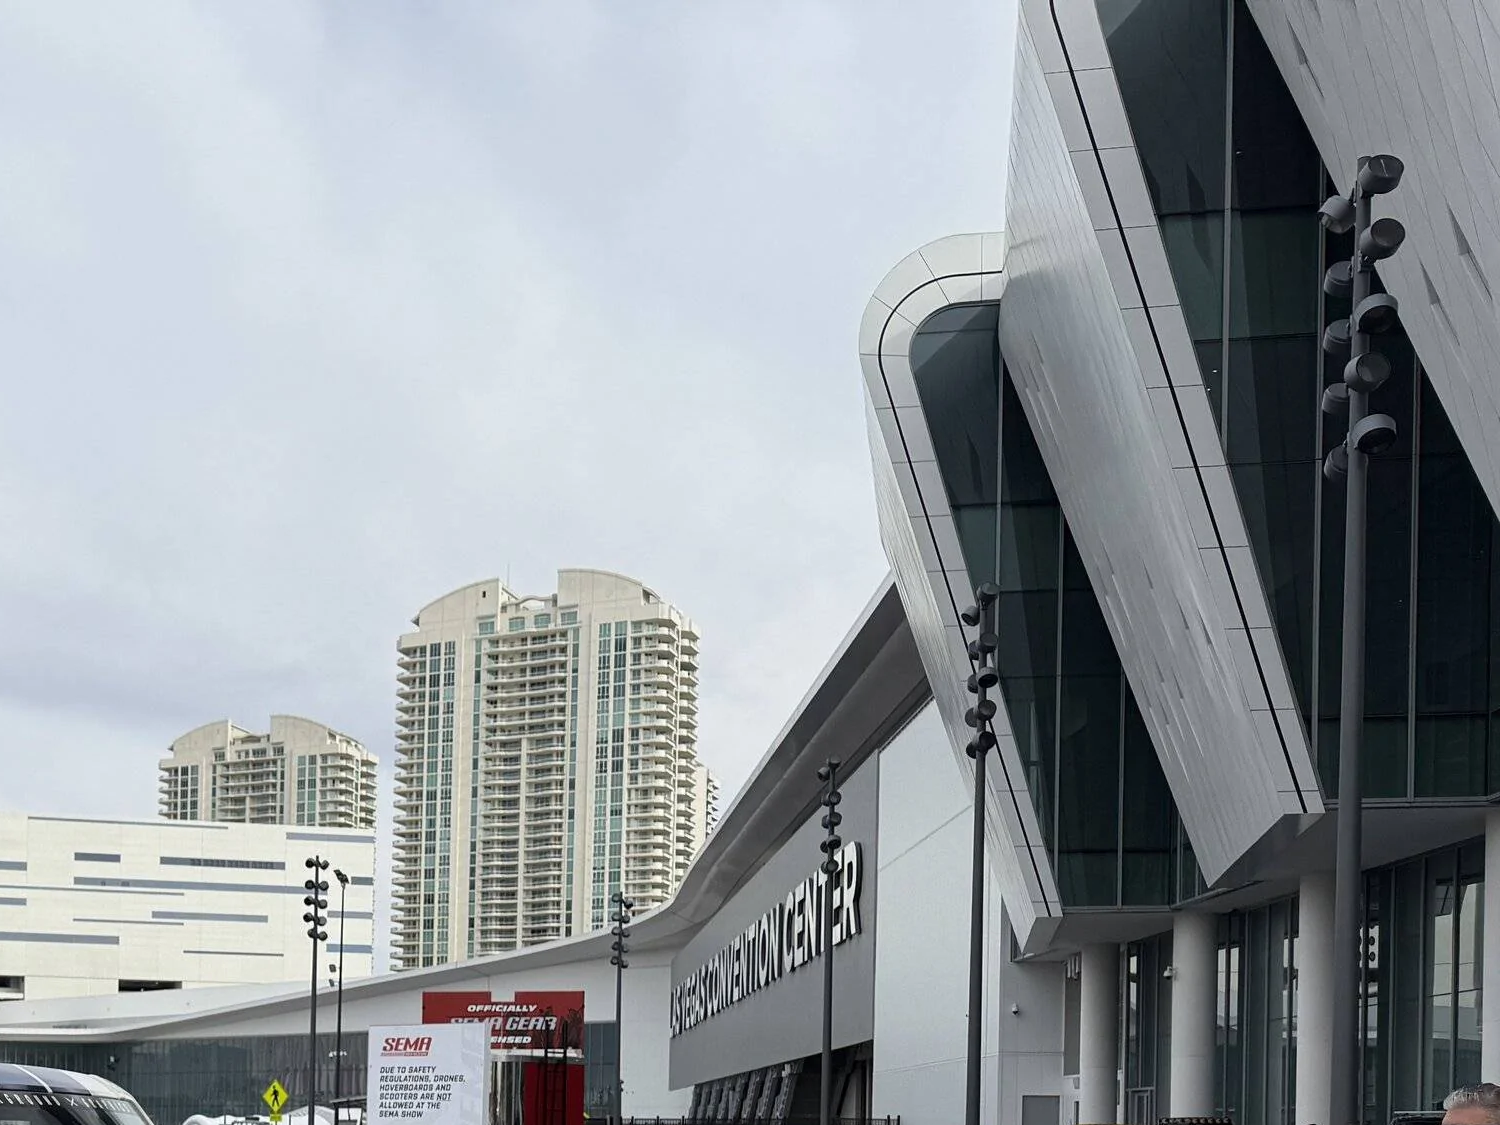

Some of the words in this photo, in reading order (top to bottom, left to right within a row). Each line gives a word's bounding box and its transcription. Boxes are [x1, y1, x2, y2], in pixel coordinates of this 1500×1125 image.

[681, 964, 706, 1032] VEGAS
[705, 903, 782, 1017] CONVENTION
[784, 841, 862, 972] CENTER
[467, 1004, 538, 1013] OFFICIALLY
[505, 1016, 557, 1031] GEAR
[382, 1036, 433, 1052] SEMA
[490, 1035, 532, 1044] ENSED
[380, 1066, 395, 1074] DUE
[397, 1066, 407, 1074] TO
[408, 1066, 437, 1074] SAFETY
[380, 1075, 432, 1083] REGULATIONS,
[433, 1074, 466, 1083] DRONES,
[379, 1084, 434, 1092] HOVERBOARDS
[435, 1084, 452, 1092] AND
[379, 1093, 418, 1101] SCOOTERS
[420, 1093, 435, 1101] ARE
[436, 1093, 452, 1101] NOT
[379, 1110, 399, 1118] SEMA
[400, 1110, 423, 1118] SHOW
